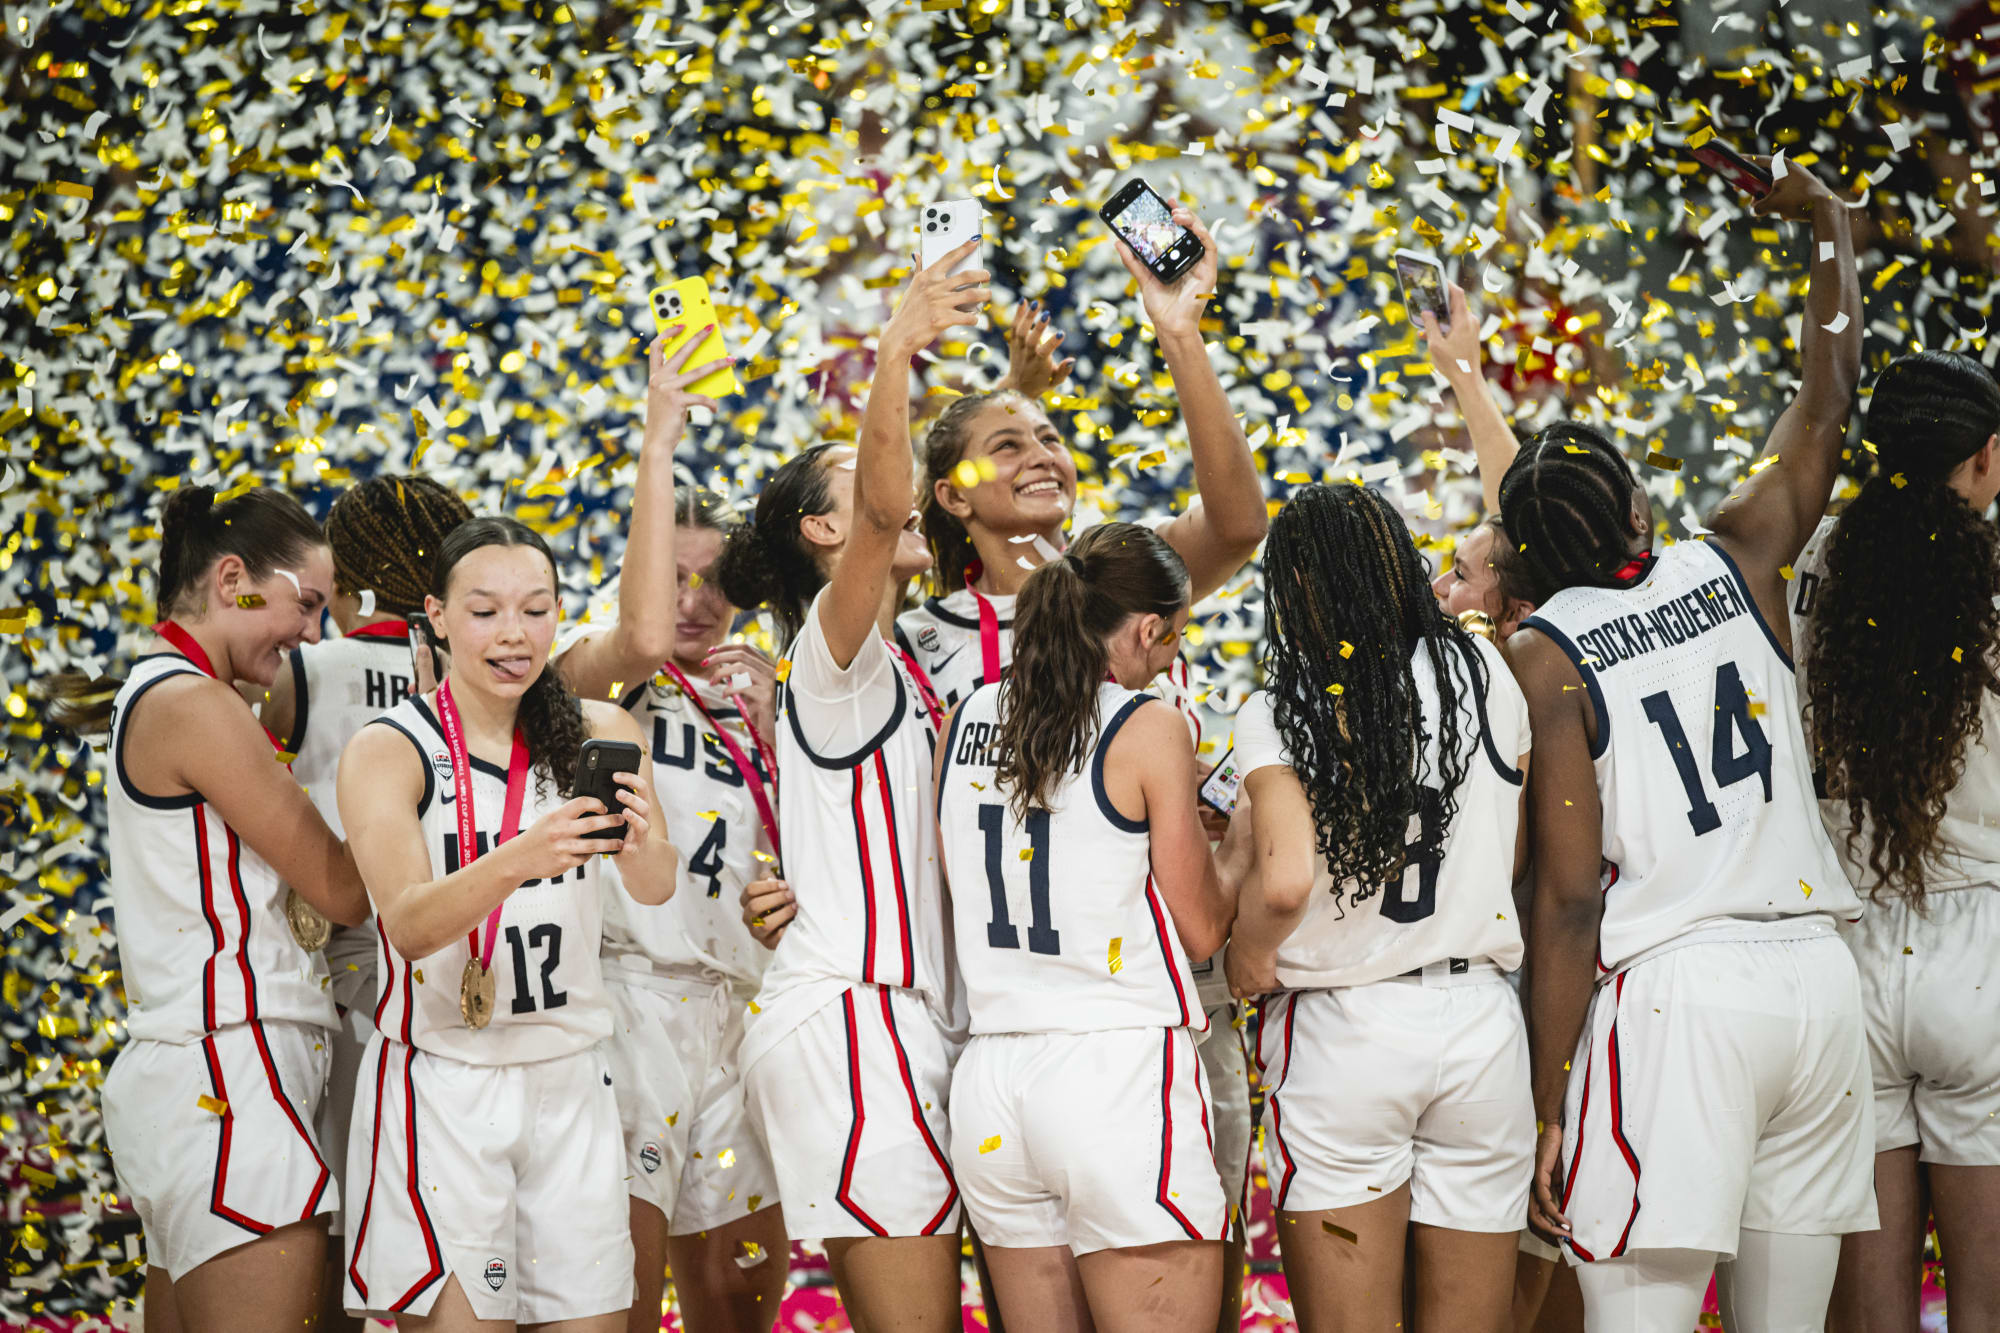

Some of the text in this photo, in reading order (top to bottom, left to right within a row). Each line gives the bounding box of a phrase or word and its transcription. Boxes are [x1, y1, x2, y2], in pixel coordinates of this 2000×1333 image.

[1576, 574, 1748, 673] SOCKA-NGUEMEN
[1640, 661, 1773, 837] 14
[688, 816, 727, 899] 4
[978, 804, 1061, 955] 11
[505, 923, 567, 1014] 12
